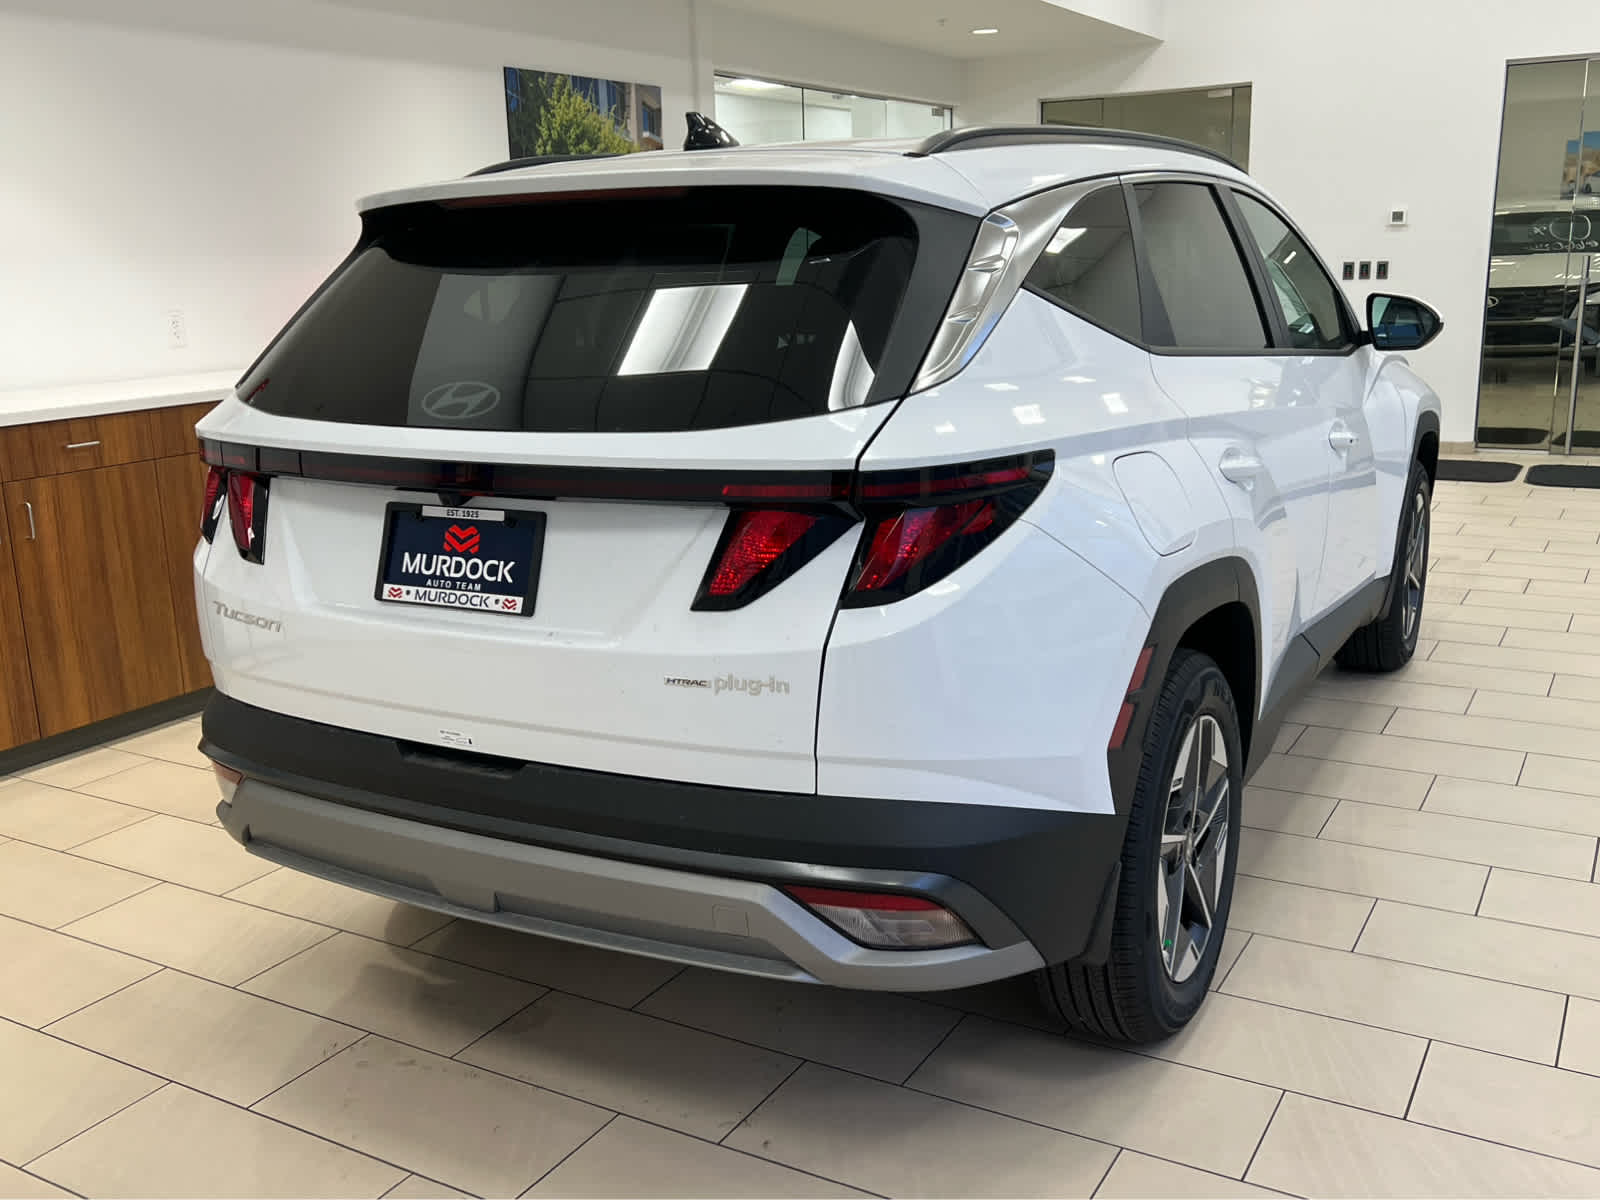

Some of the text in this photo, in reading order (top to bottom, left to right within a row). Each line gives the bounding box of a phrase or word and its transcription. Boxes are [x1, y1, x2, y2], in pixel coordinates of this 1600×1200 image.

[462, 509, 480, 518] 1925
[402, 552, 515, 583] MURDOCK
[426, 578, 482, 592] AUTO TEAM
[414, 588, 490, 608] MURDOCK
[665, 673, 790, 696] HTRAC plug-in
